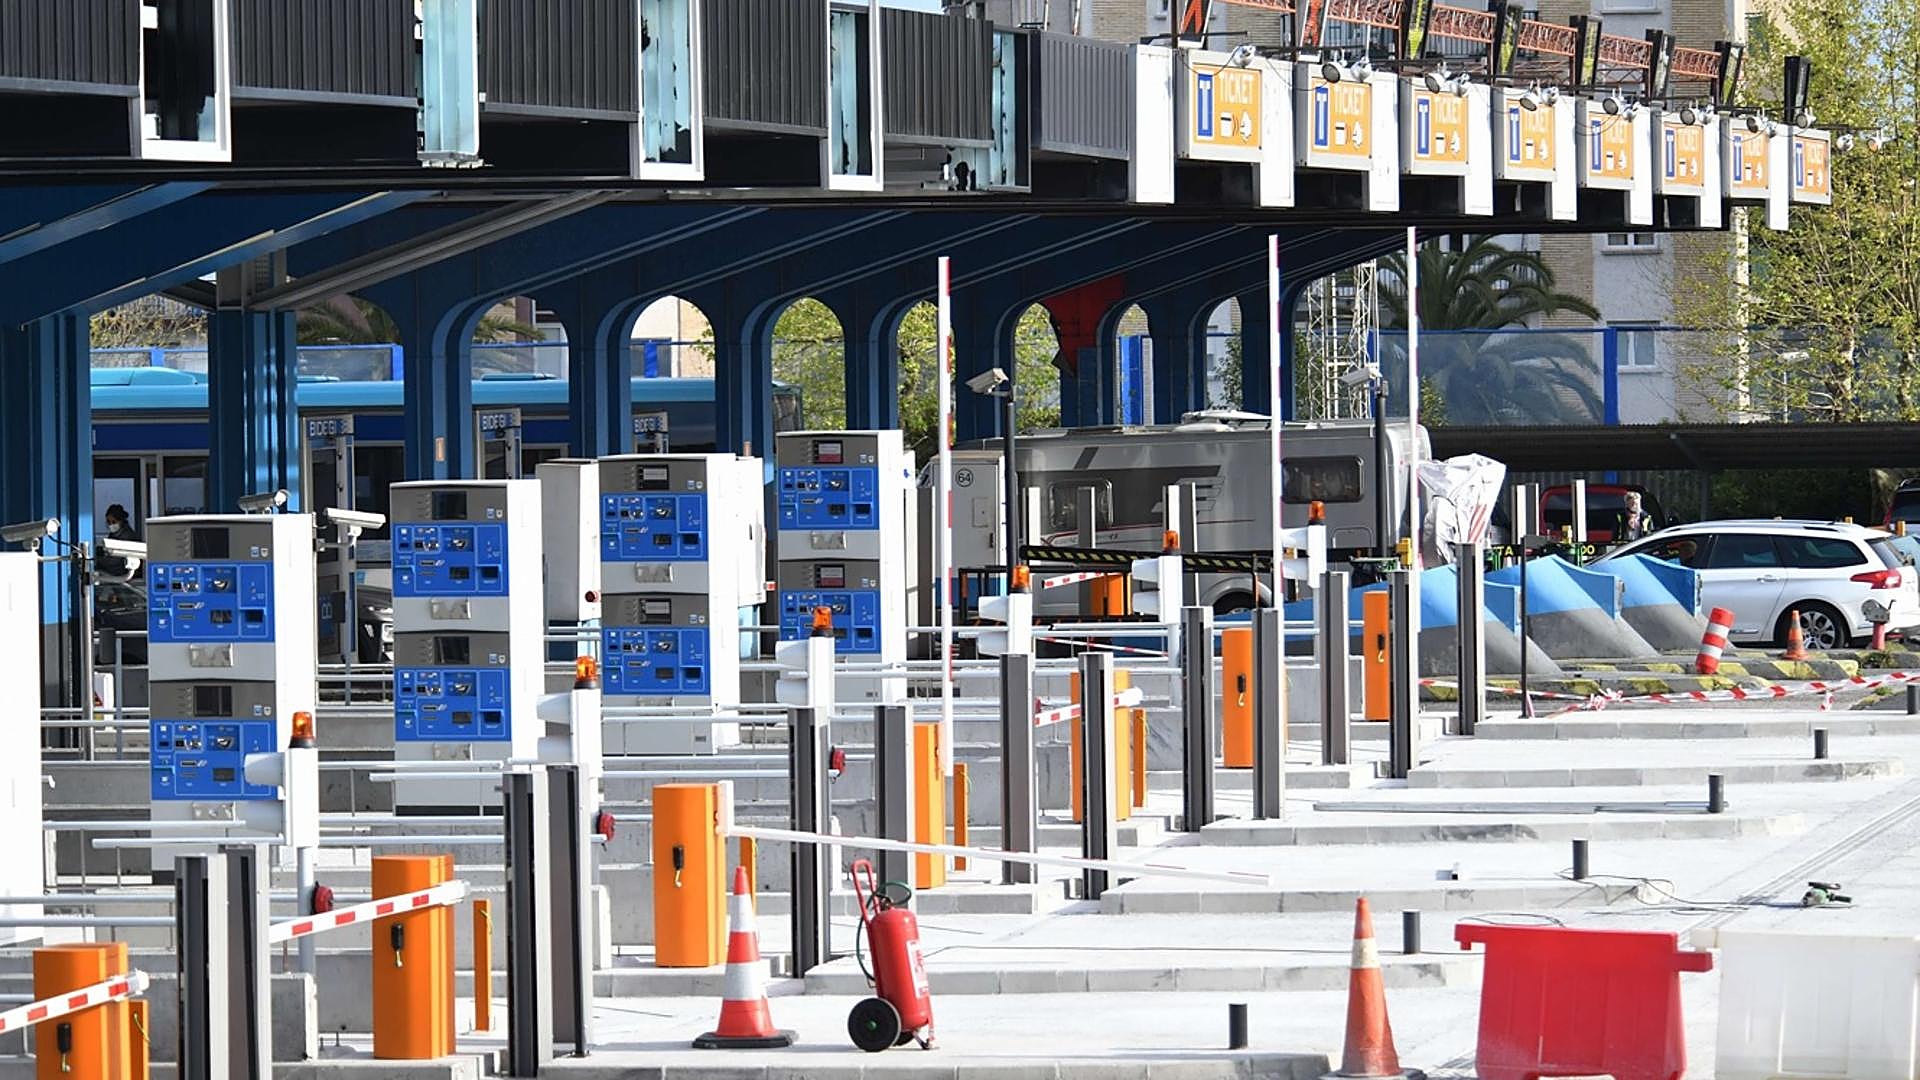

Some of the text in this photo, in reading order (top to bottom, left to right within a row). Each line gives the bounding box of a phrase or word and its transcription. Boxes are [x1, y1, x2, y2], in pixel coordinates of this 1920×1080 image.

[1219, 73, 1254, 105] TICKET
[1334, 86, 1366, 116] TICKET
[959, 472, 970, 483] 64
